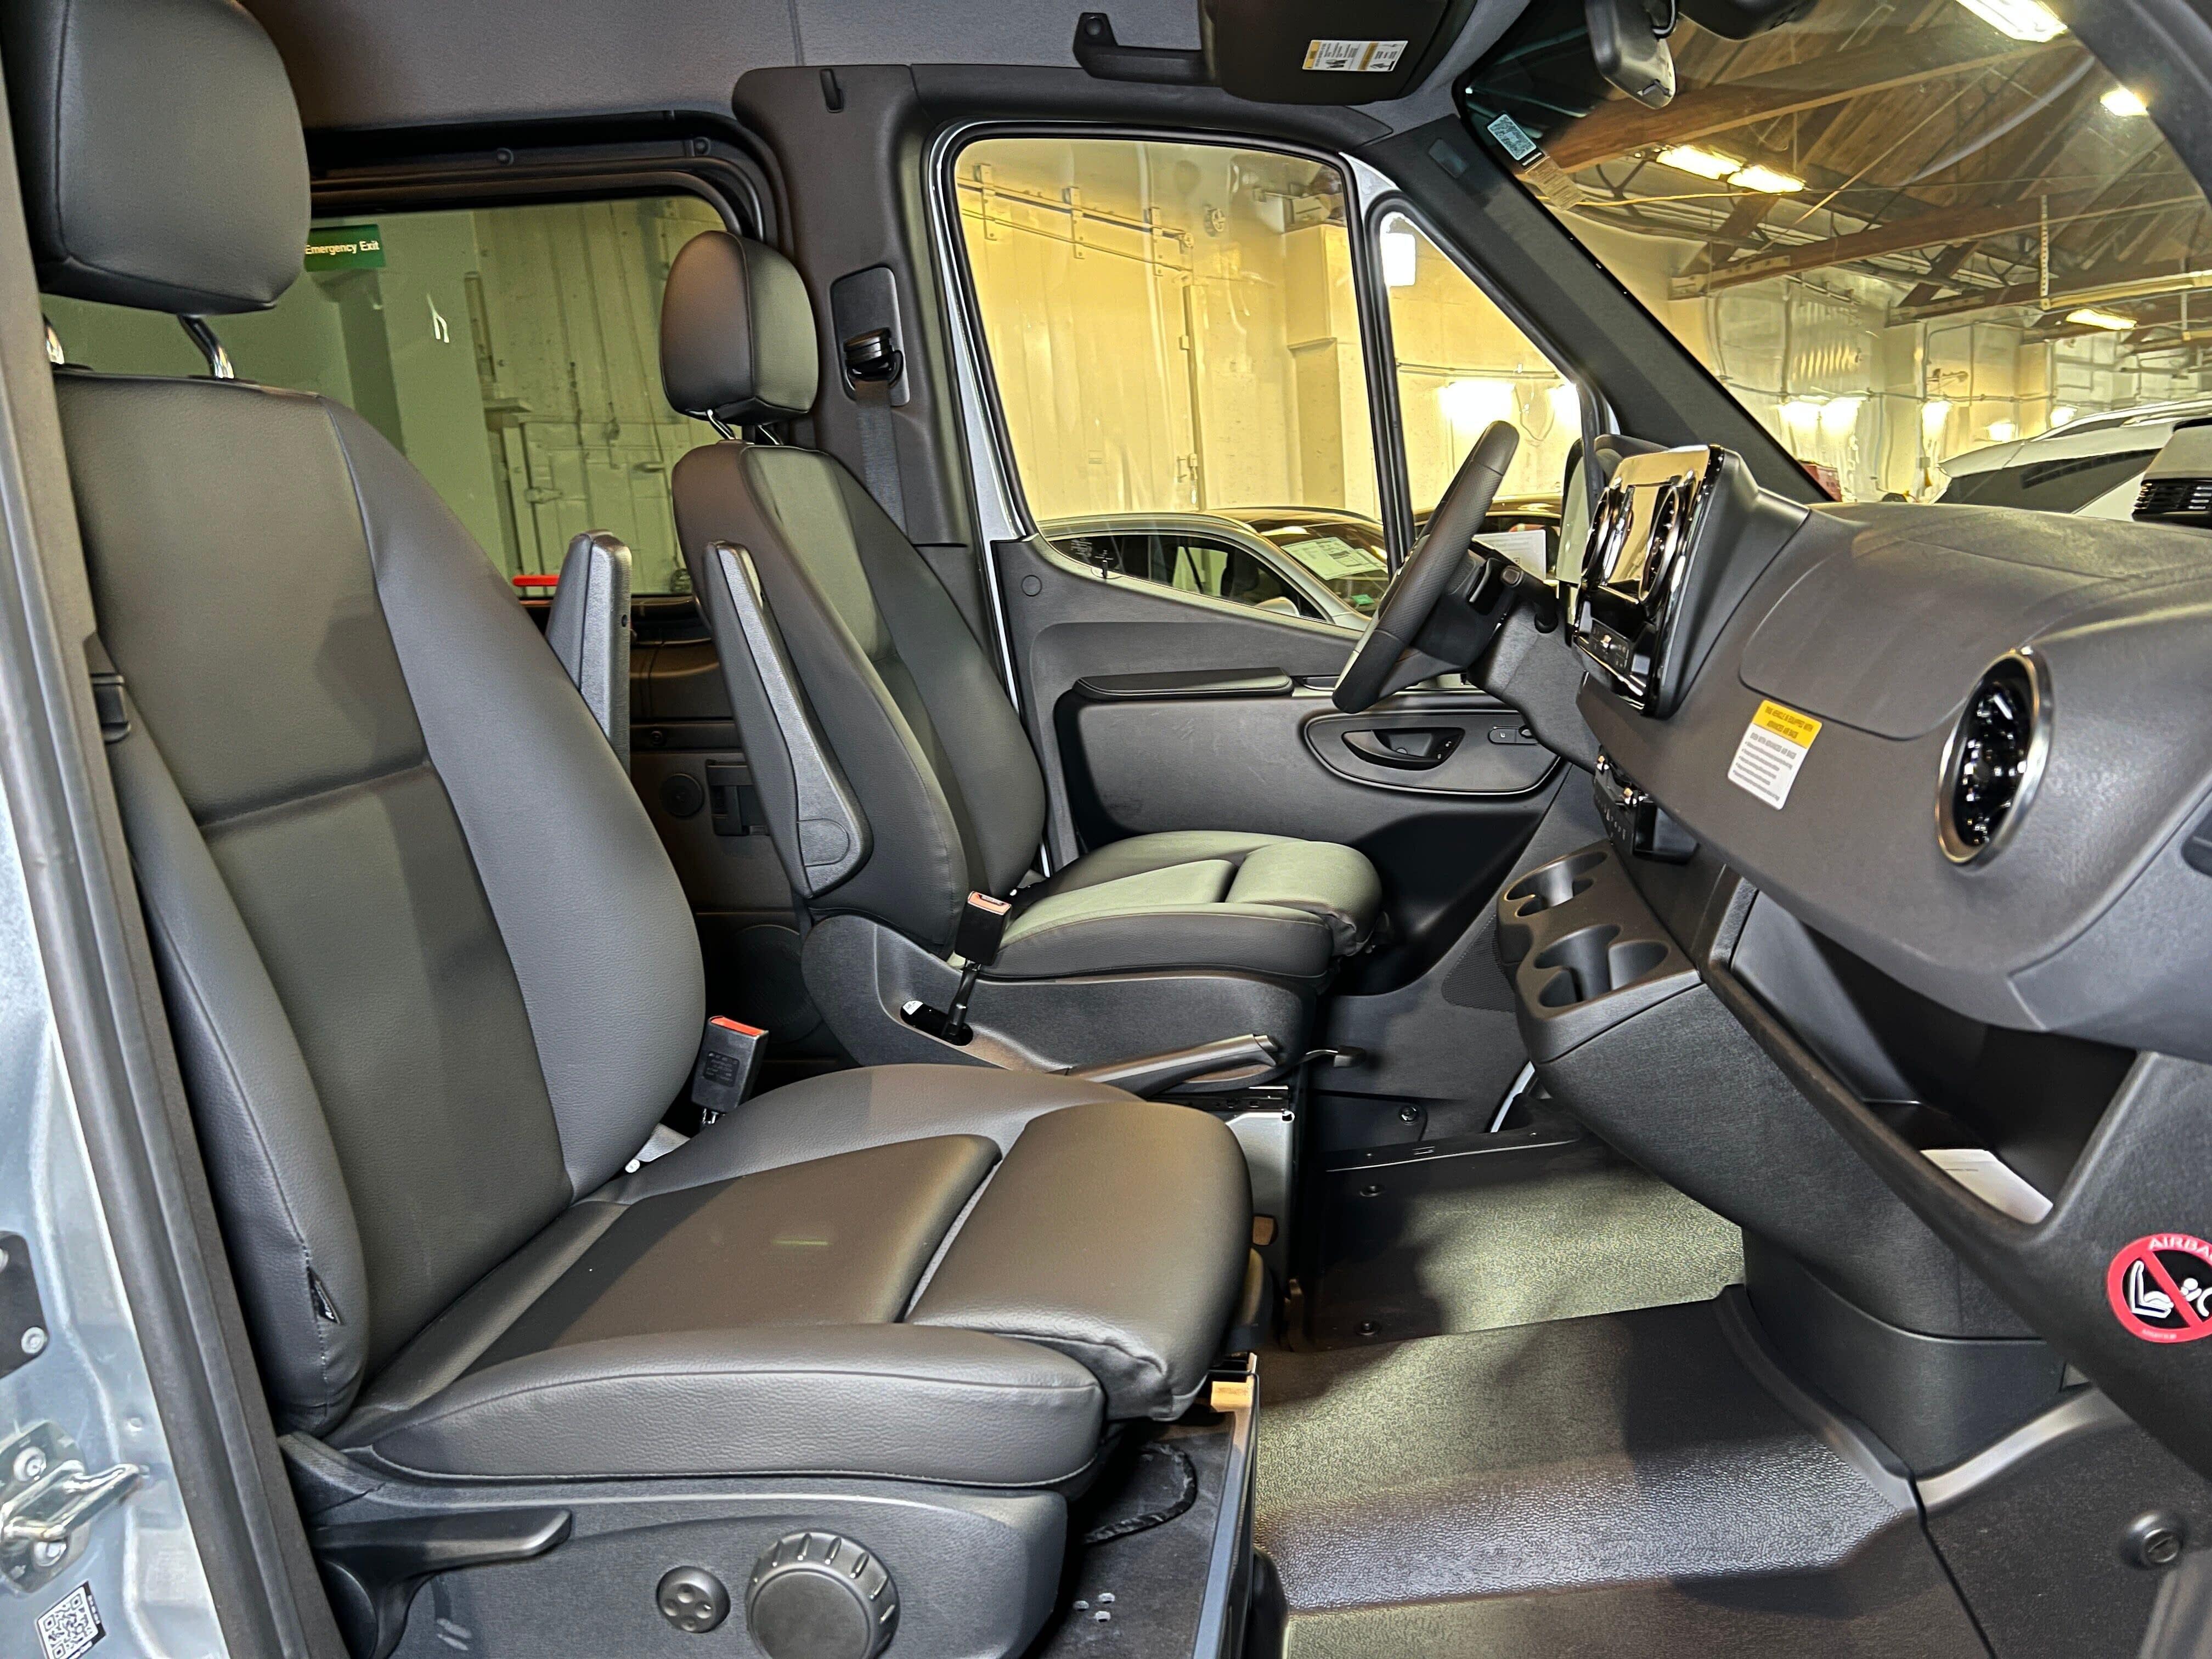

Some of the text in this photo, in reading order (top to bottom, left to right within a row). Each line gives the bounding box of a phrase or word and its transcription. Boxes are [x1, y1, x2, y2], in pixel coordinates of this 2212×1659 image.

[305, 240, 380, 255] Emergency Exit
[2148, 1237, 2212, 1261] AIRBA
